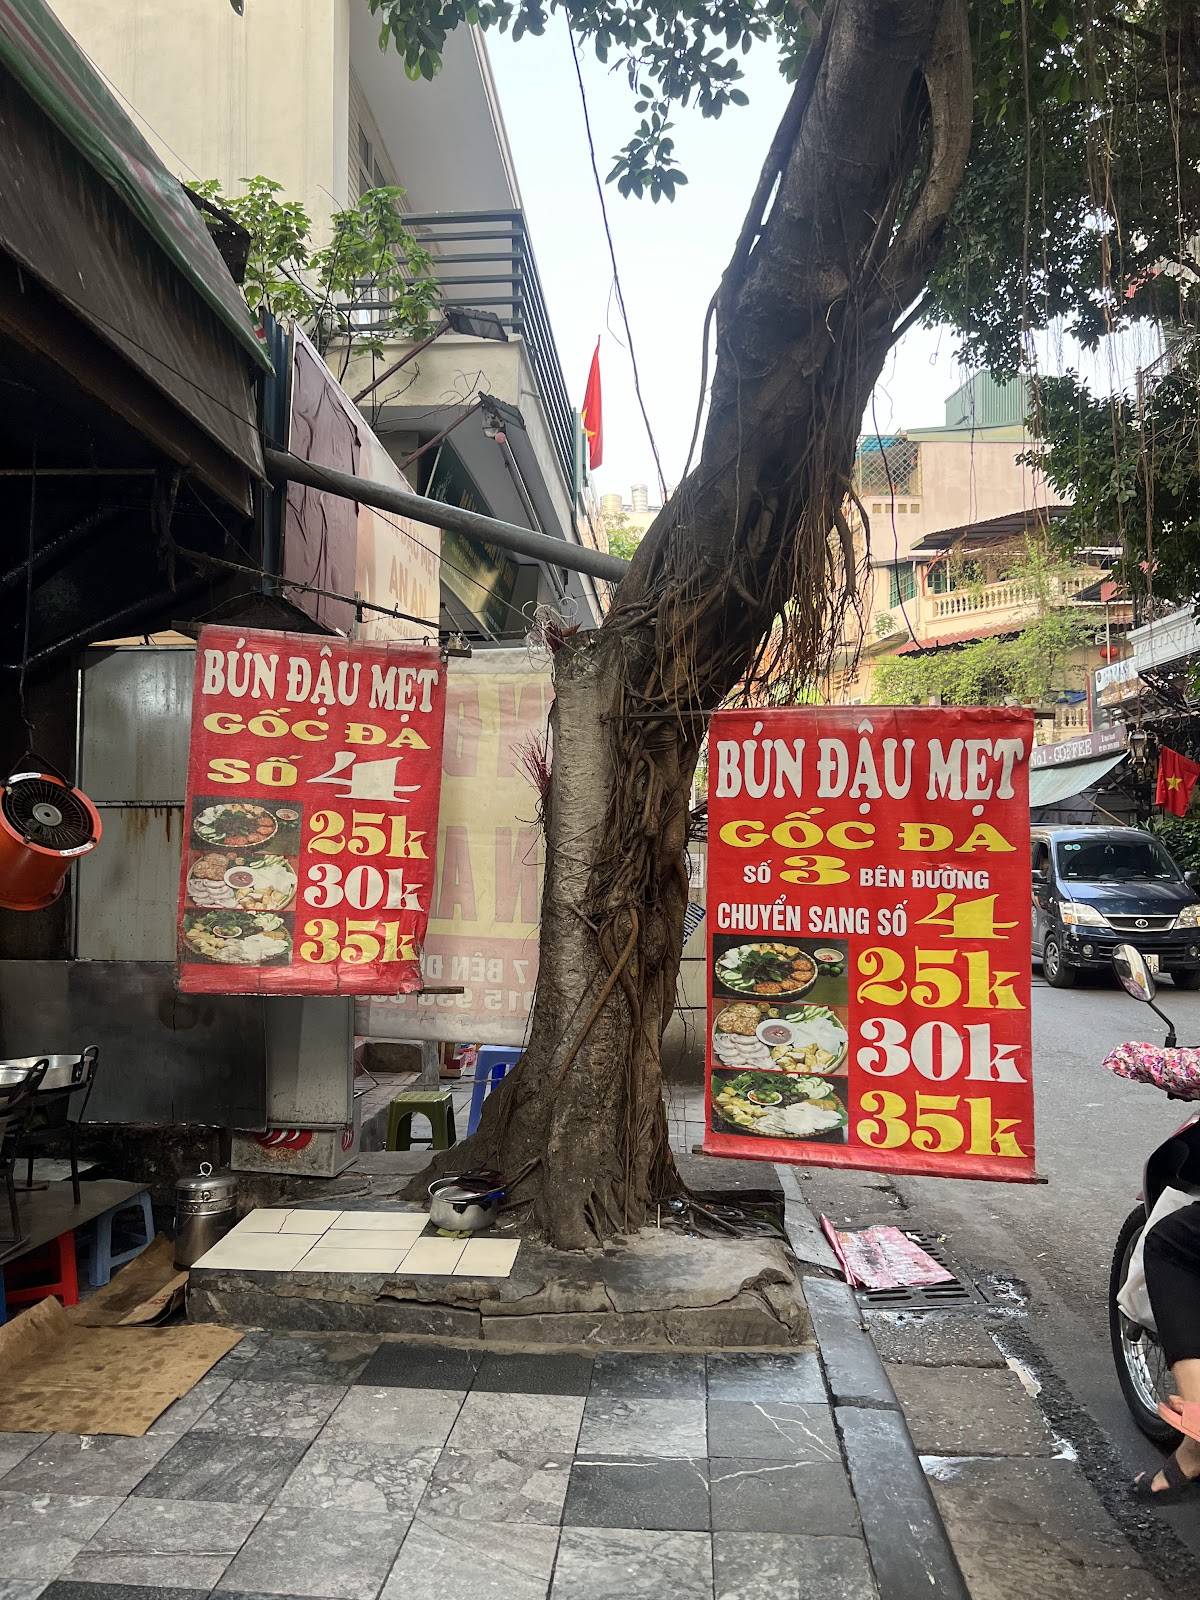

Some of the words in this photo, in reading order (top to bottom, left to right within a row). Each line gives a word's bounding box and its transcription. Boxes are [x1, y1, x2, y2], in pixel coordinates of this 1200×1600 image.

[202, 637, 280, 700] BÚN
[285, 644, 362, 716] ĐẬU
[368, 663, 439, 723] MẸT
[203, 707, 330, 742] GỐC
[344, 722, 432, 750] ĐA
[1053, 738, 1093, 762] COFFEE
[207, 755, 304, 787] SỐ
[306, 751, 423, 802] 4
[715, 721, 806, 799] BÚN
[816, 718, 914, 815] ĐẬU
[925, 737, 1024, 817] MẸT
[307, 809, 430, 860] 25k
[719, 807, 877, 850] GỐC
[897, 822, 1018, 853] ĐA
[303, 863, 425, 912] 30k
[743, 859, 773, 884] SỐ
[779, 854, 851, 885] 3
[859, 864, 905, 888] BÊN
[911, 866, 990, 890] ĐƯỜNG
[300, 916, 420, 965] 35k
[717, 893, 801, 933] CHUYỂN
[808, 905, 870, 936] SANG
[877, 899, 907, 937] SỐ
[914, 893, 1019, 939] 4
[856, 946, 1027, 1010] 25k
[856, 1017, 1028, 1084] 30k
[856, 1090, 1028, 1158] 35k
